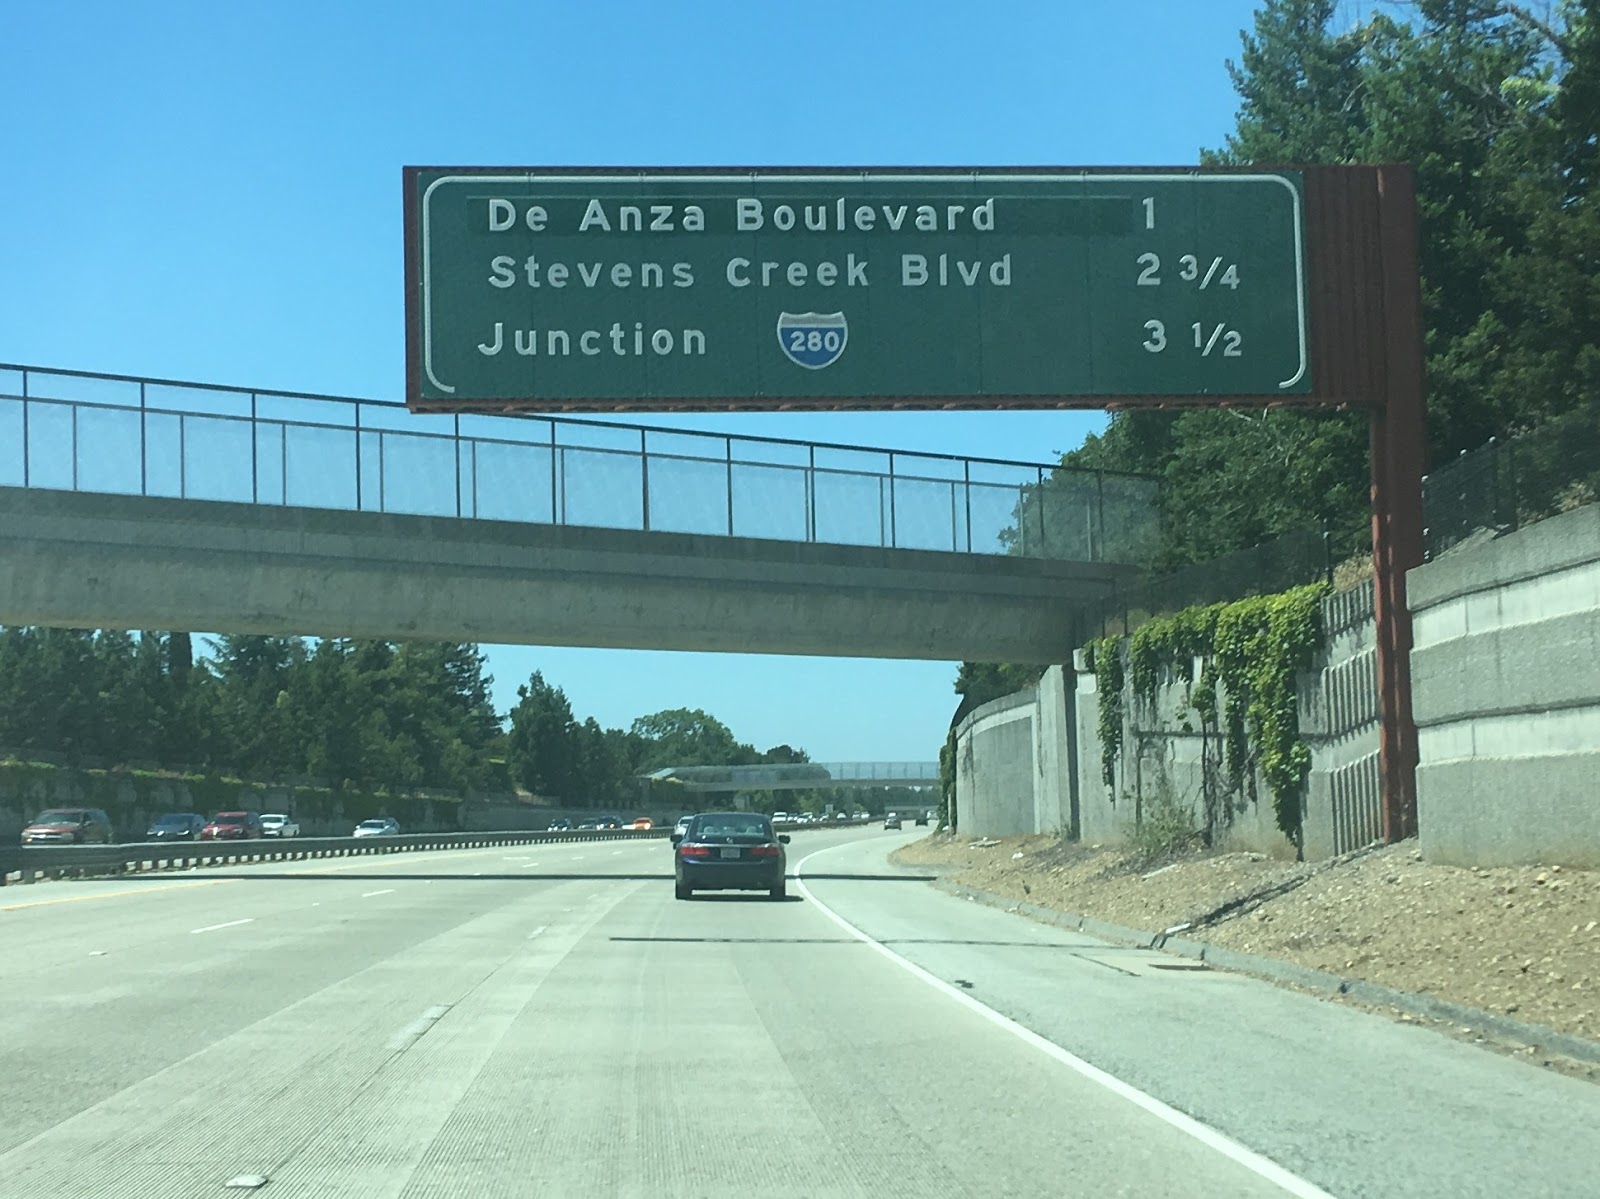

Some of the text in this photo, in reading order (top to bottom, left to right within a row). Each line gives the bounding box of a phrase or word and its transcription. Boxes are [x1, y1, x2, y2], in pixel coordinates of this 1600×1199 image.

[488, 197, 1154, 232] De Anza Boulevard 1
[488, 252, 1240, 290] Stevens Creek Blvd 2 3/4
[477, 319, 1242, 357] Junction 280 3 1/2
